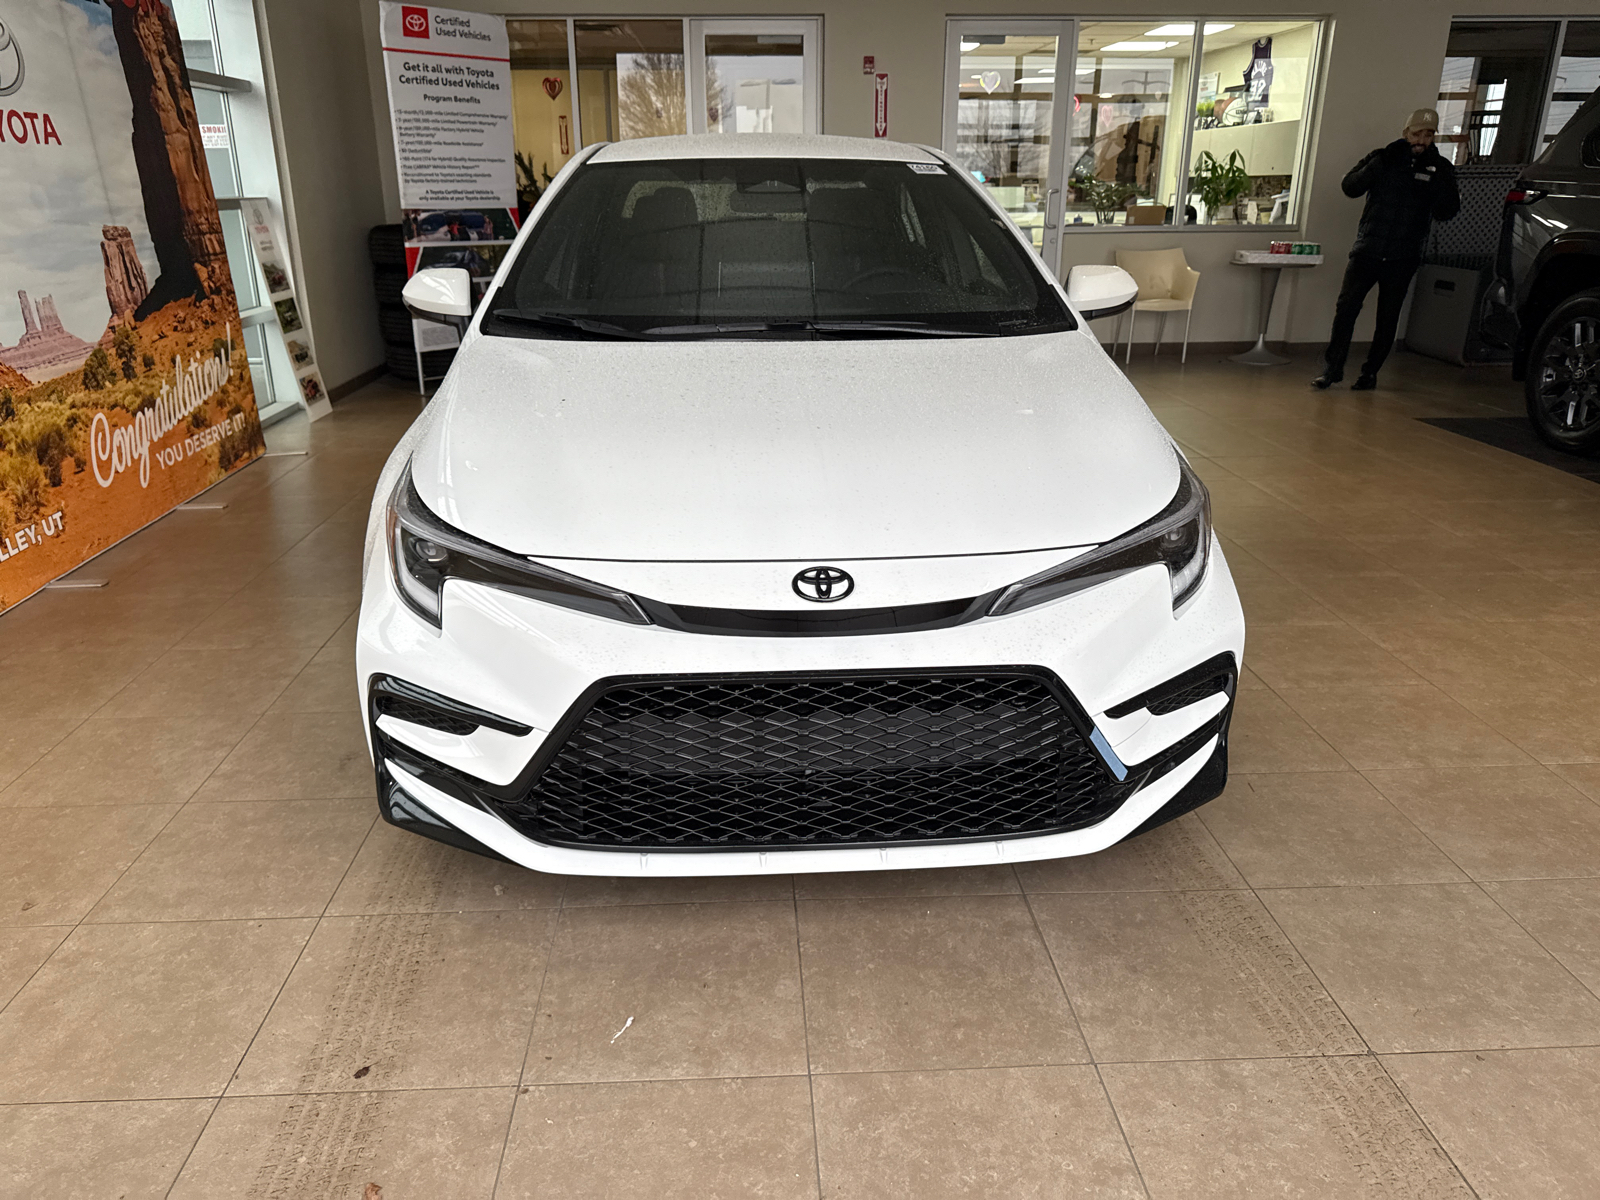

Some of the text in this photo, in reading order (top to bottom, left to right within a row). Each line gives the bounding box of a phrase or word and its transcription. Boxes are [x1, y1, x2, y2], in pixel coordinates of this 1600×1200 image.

[434, 15, 471, 28] Certified
[435, 27, 491, 42] Used Vehicles
[403, 61, 495, 79] Get it all with Toyota
[398, 74, 500, 91] Certified Used Vehicles
[423, 93, 481, 104] Program Benefits
[90, 321, 234, 488] Congratulations!
[155, 412, 247, 470] YOU DESERVE IT!
[41, 510, 63, 536] UT
